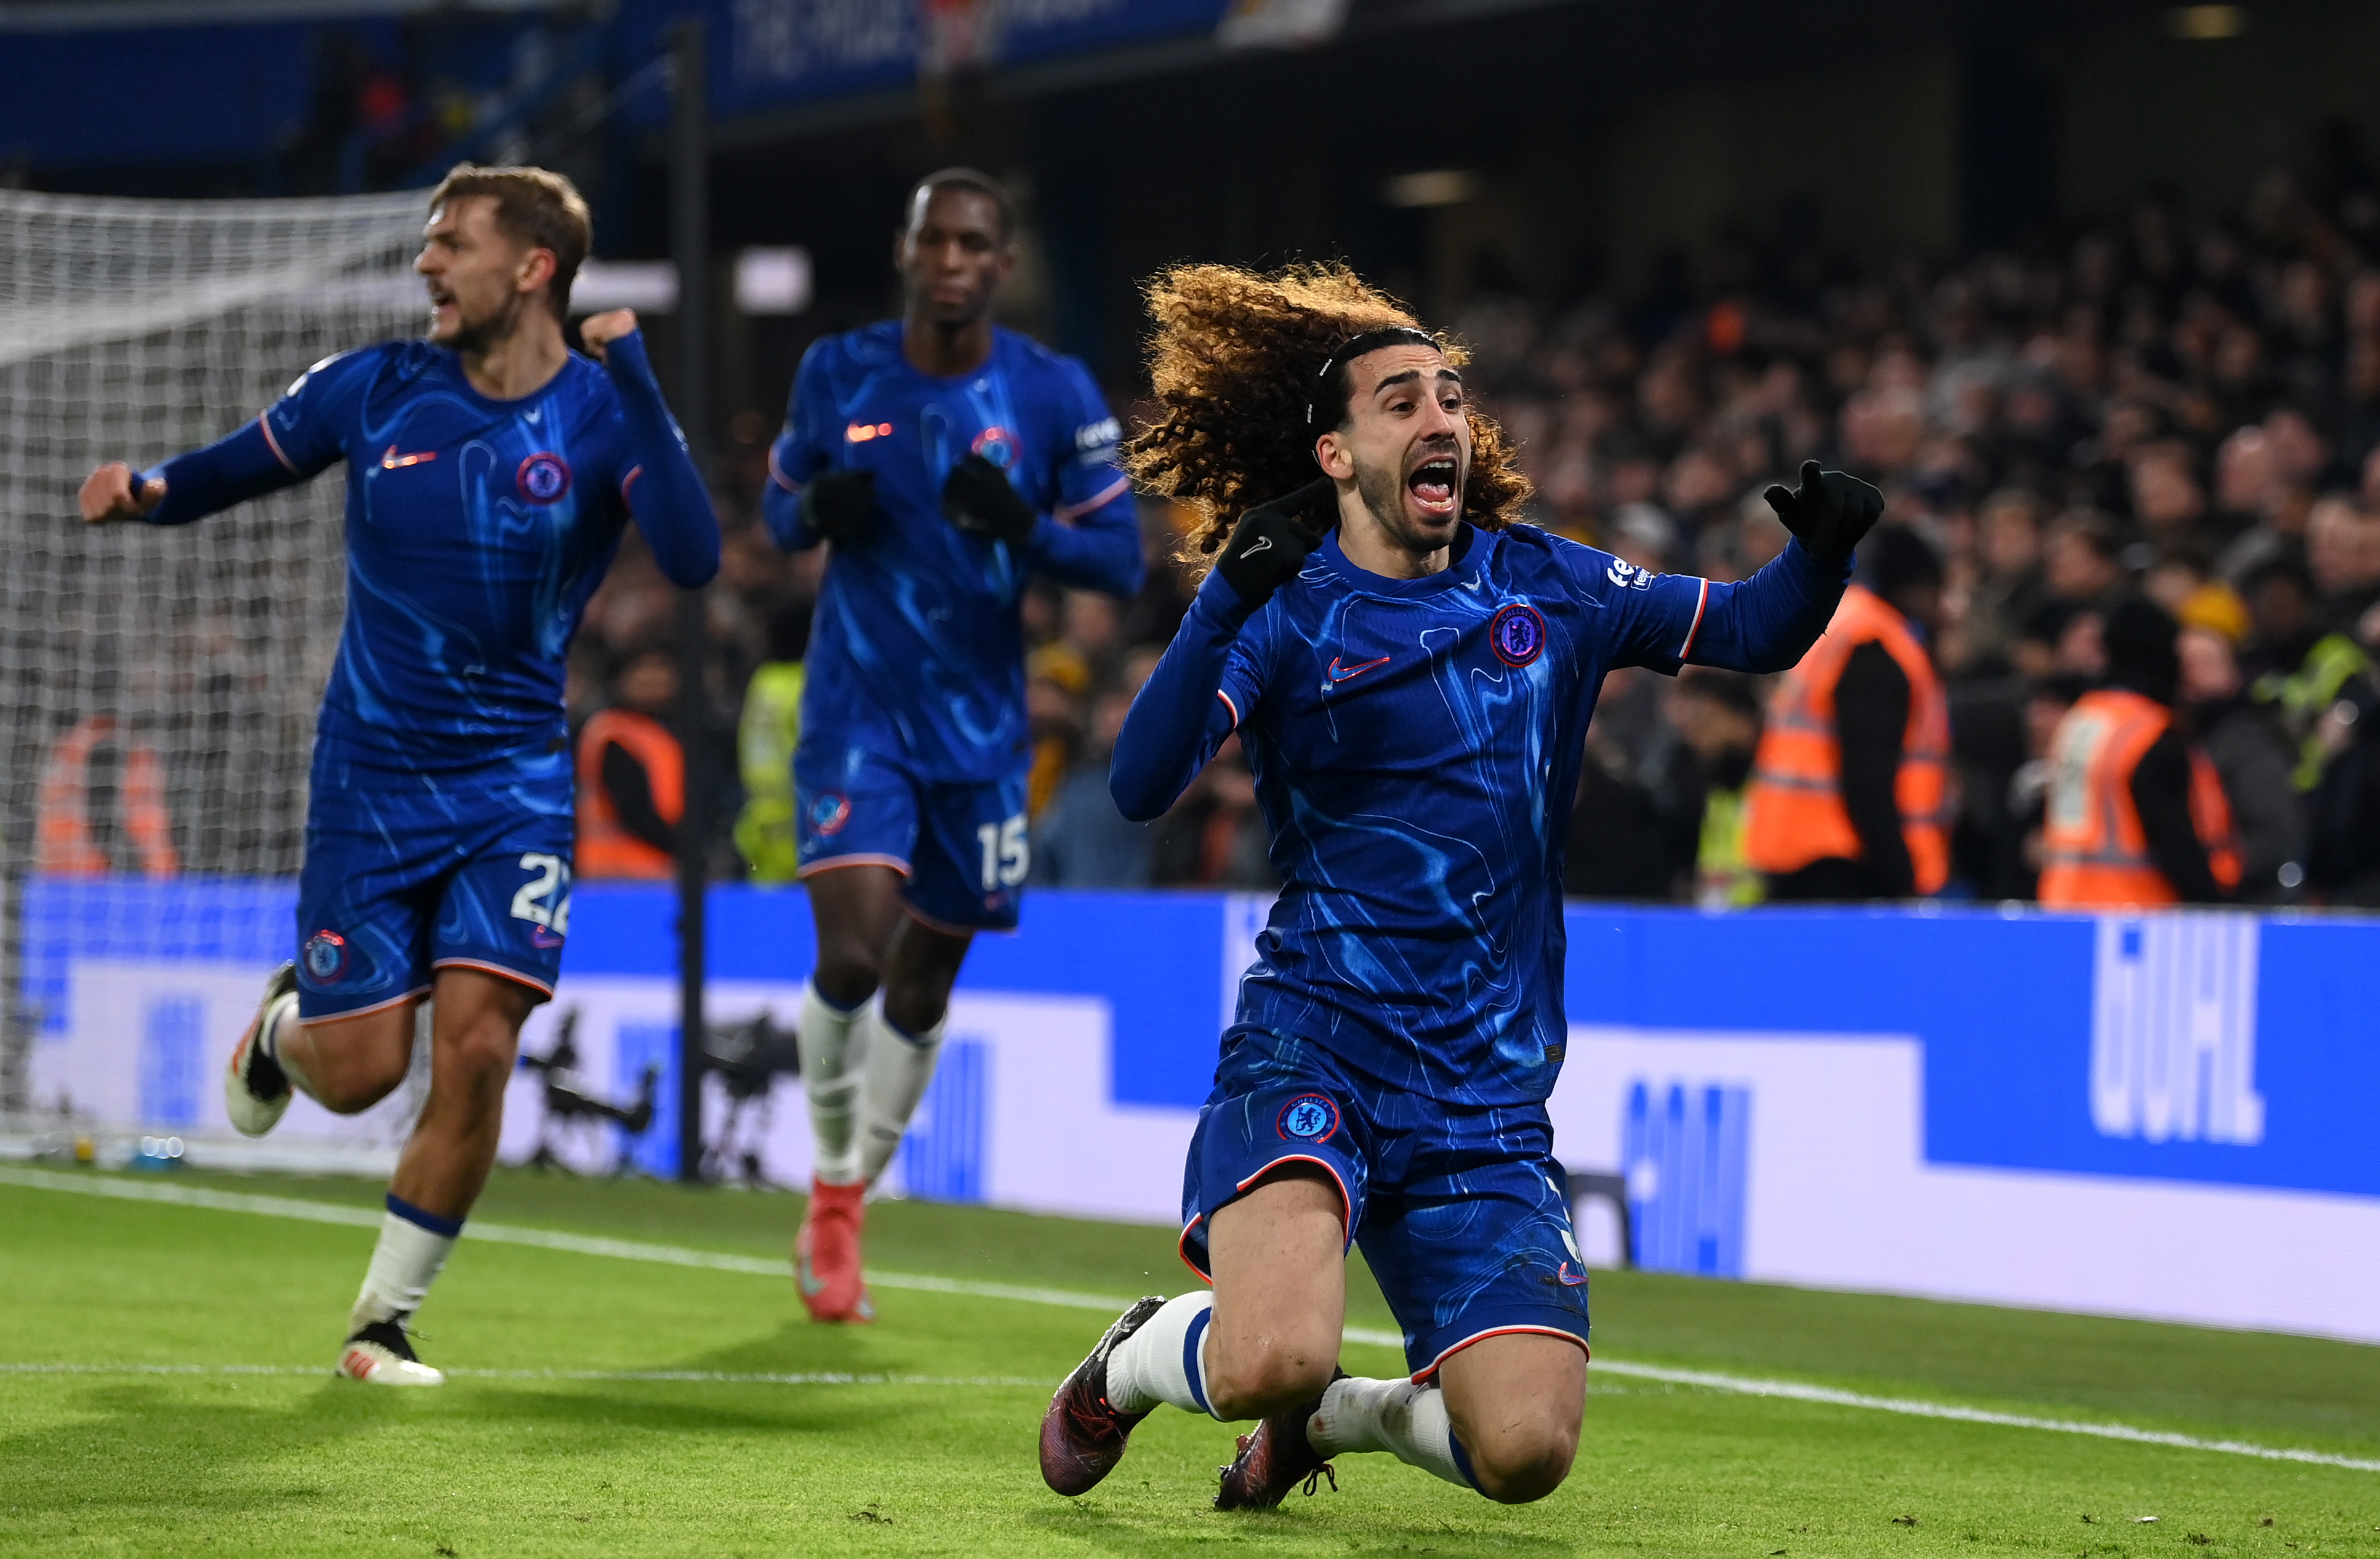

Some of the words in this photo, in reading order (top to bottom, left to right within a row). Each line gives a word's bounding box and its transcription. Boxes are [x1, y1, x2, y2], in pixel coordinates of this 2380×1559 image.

[1500, 608, 1534, 621] CHELSEA
[976, 818, 1031, 892] 15
[1291, 1097, 1329, 1109] CHELSEA
